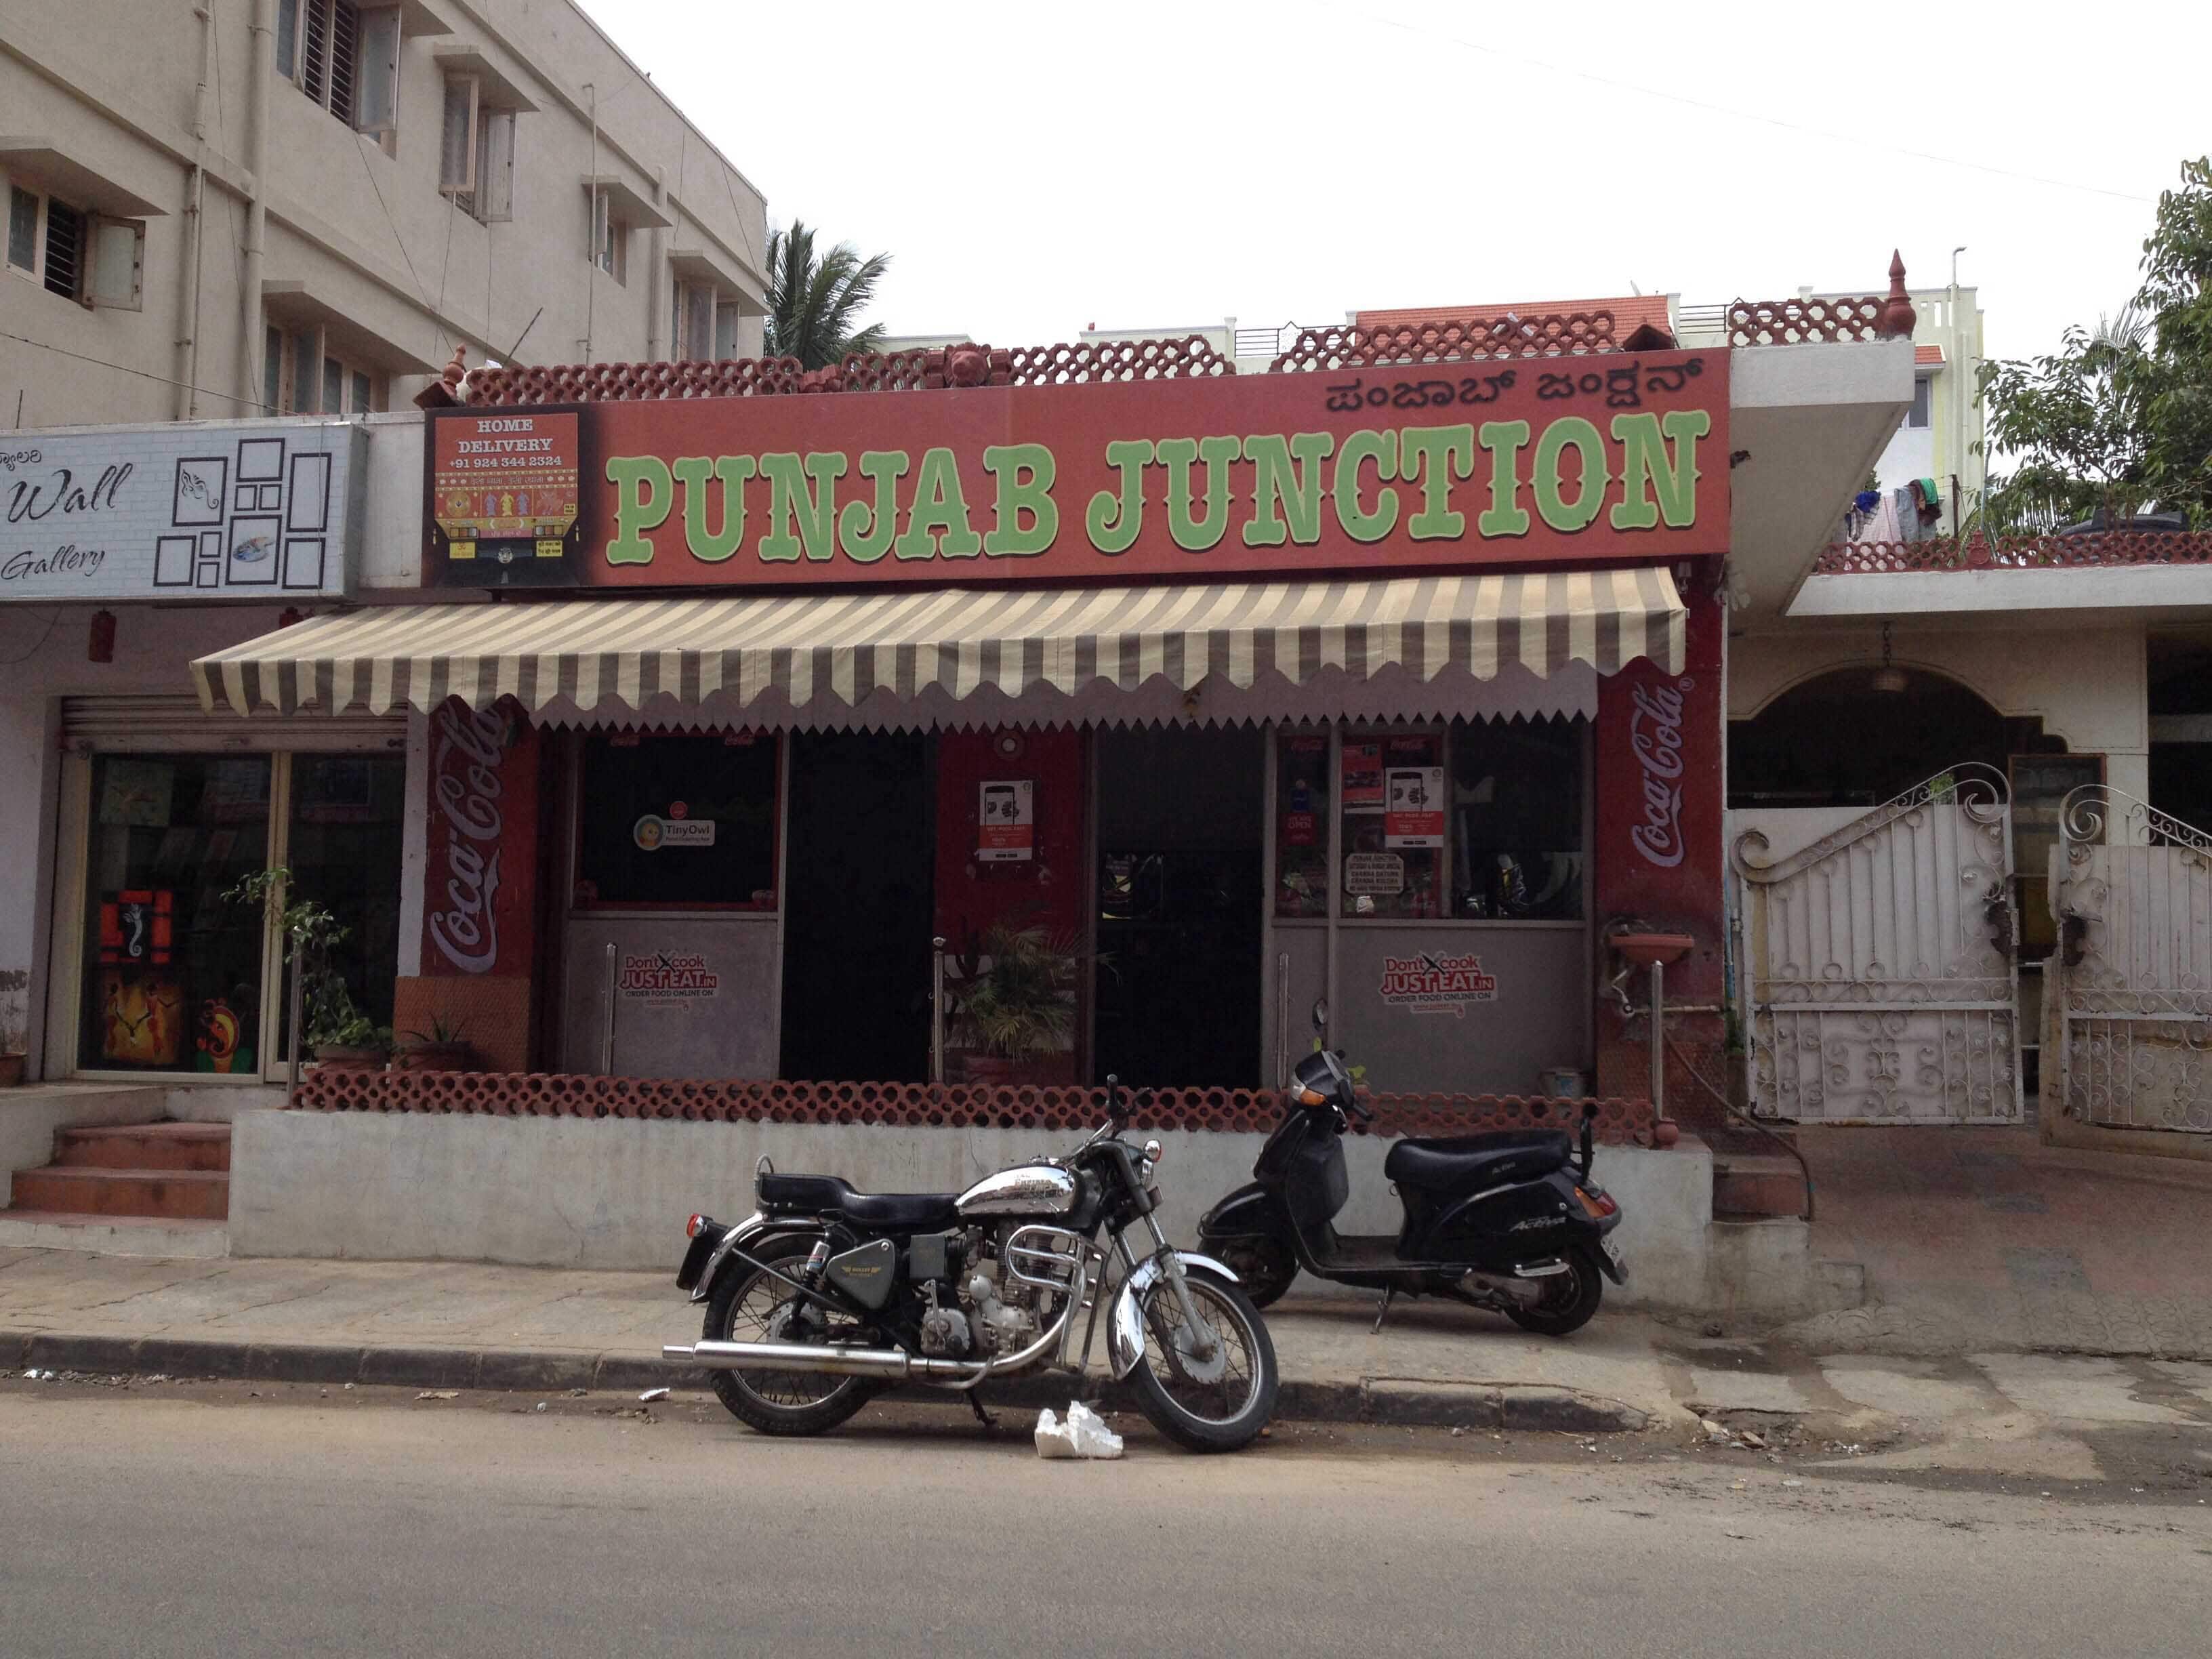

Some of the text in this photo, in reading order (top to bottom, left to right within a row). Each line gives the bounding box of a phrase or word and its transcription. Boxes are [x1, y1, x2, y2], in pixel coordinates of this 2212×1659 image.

[477, 419, 533, 433] HOME
[458, 438, 553, 453] DELIVERY
[449, 459, 470, 468] +91
[474, 457, 498, 468] 924
[7, 462, 133, 523] Wall
[605, 409, 1711, 565] PUNJAB JUNCTION
[1, 543, 105, 581] Gallery
[666, 825, 710, 836] TinyOwl
[626, 956, 705, 968] Don't cook
[1385, 955, 1478, 971] Don't cook
[1418, 994, 1442, 1002] FOOD
[1443, 992, 1475, 1000] ONLINE
